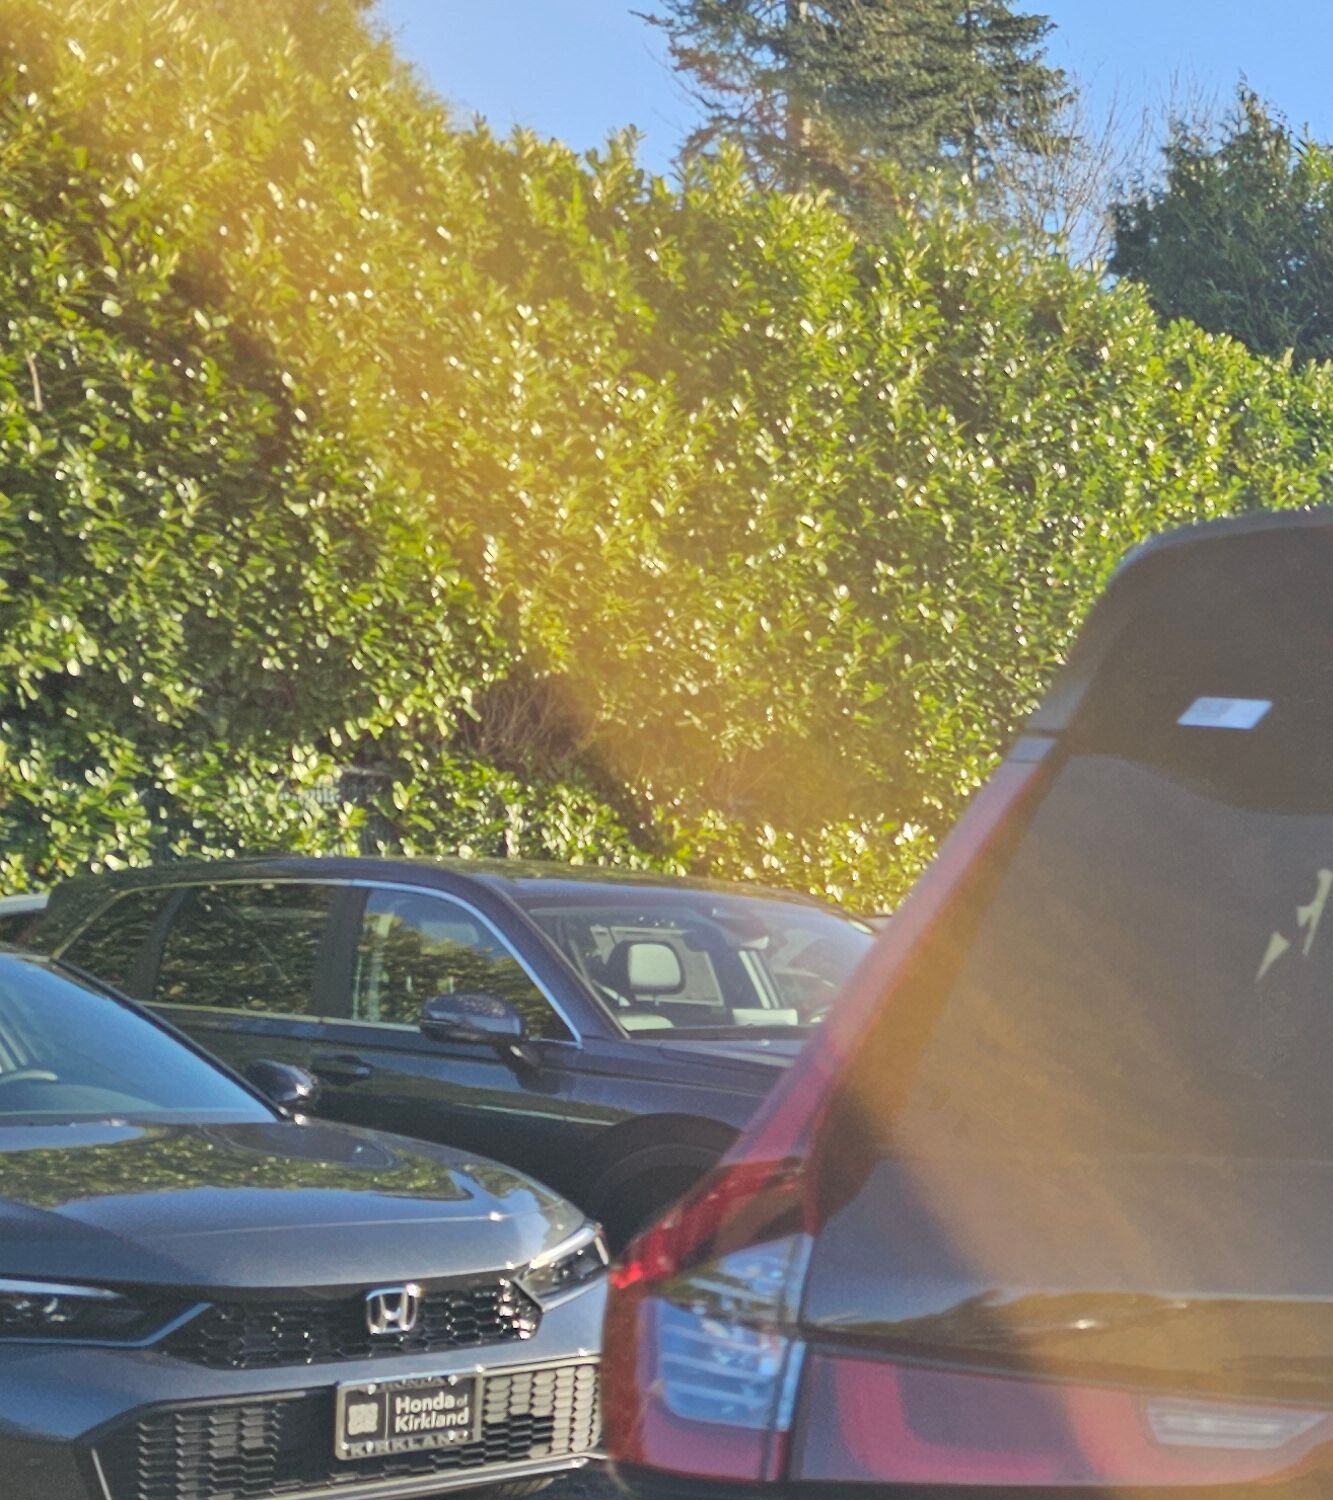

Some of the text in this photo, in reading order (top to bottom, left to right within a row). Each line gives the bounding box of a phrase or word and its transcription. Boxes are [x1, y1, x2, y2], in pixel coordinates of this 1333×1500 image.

[395, 1391, 468, 1415] Honda of
[395, 1407, 470, 1433] Kirkland
